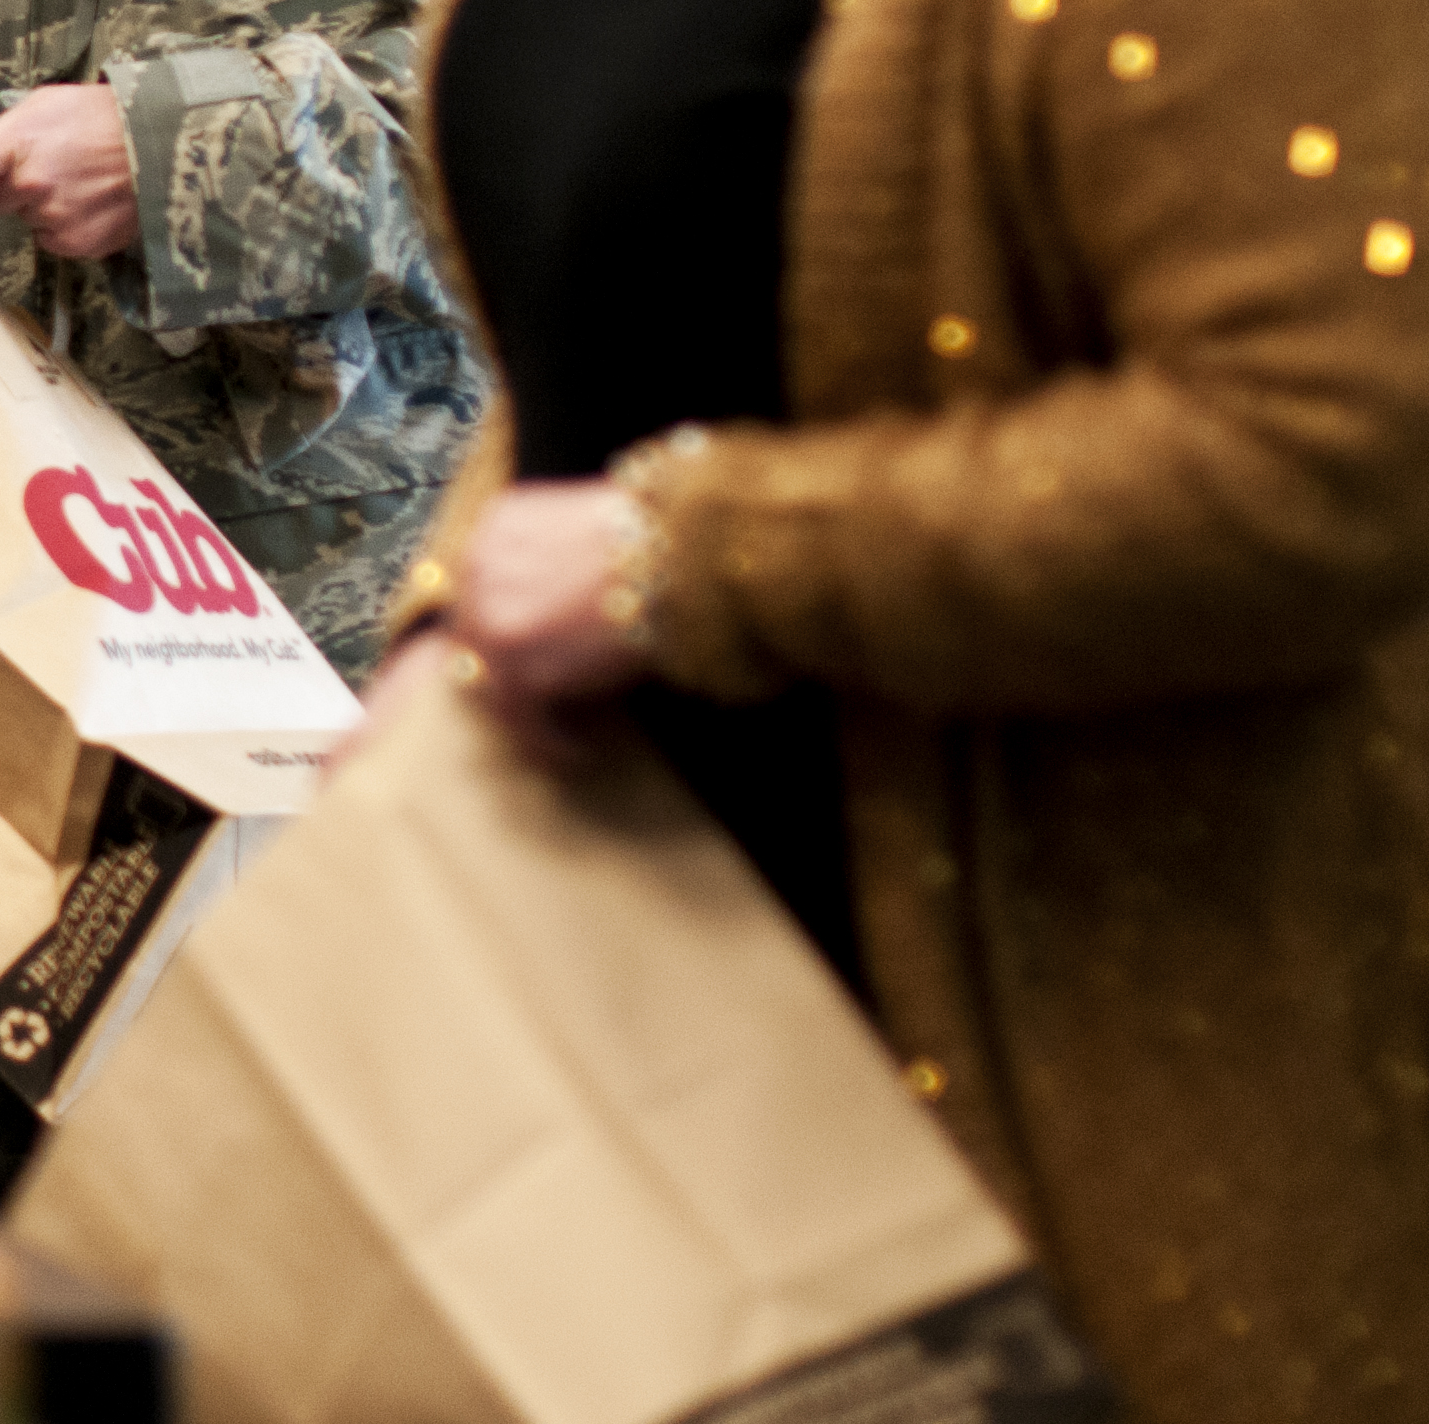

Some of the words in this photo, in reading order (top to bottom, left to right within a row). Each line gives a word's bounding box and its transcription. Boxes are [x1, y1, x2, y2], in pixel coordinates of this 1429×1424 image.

[23, 464, 261, 618] Cub
[98, 635, 133, 668] My
[242, 637, 271, 667] My
